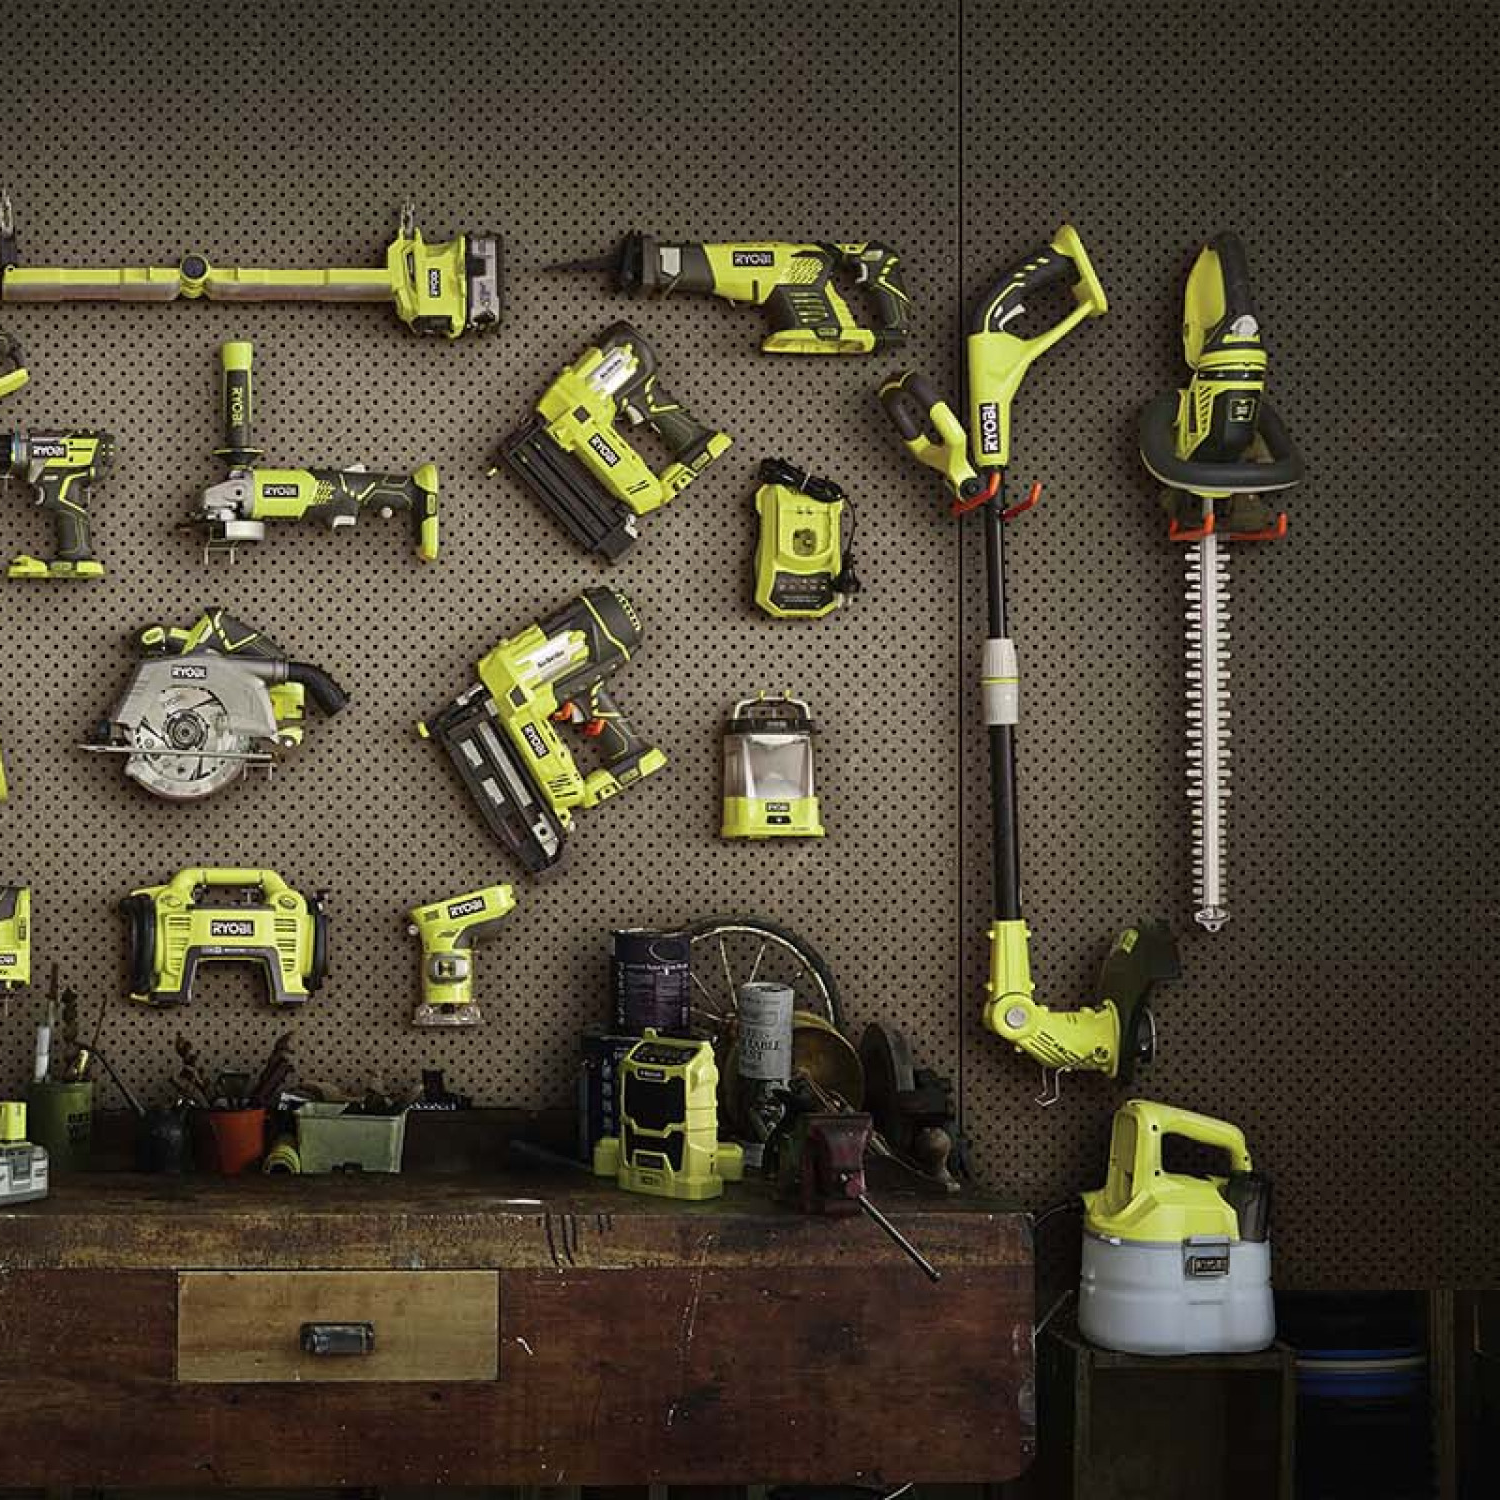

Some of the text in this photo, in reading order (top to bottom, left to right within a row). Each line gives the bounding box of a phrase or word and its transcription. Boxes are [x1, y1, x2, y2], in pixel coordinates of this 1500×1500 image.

[735, 254, 772, 264] RYOBI
[232, 387, 242, 426] RYOBI
[983, 405, 997, 451] RYOBI
[33, 445, 66, 457] RYOBI
[591, 435, 619, 464] RYOBI
[265, 486, 297, 495] RYOBI
[173, 667, 206, 677] RYOBI
[524, 726, 546, 755] RYOBI
[452, 900, 484, 916] RYOBI
[213, 923, 252, 935] RYOBI
